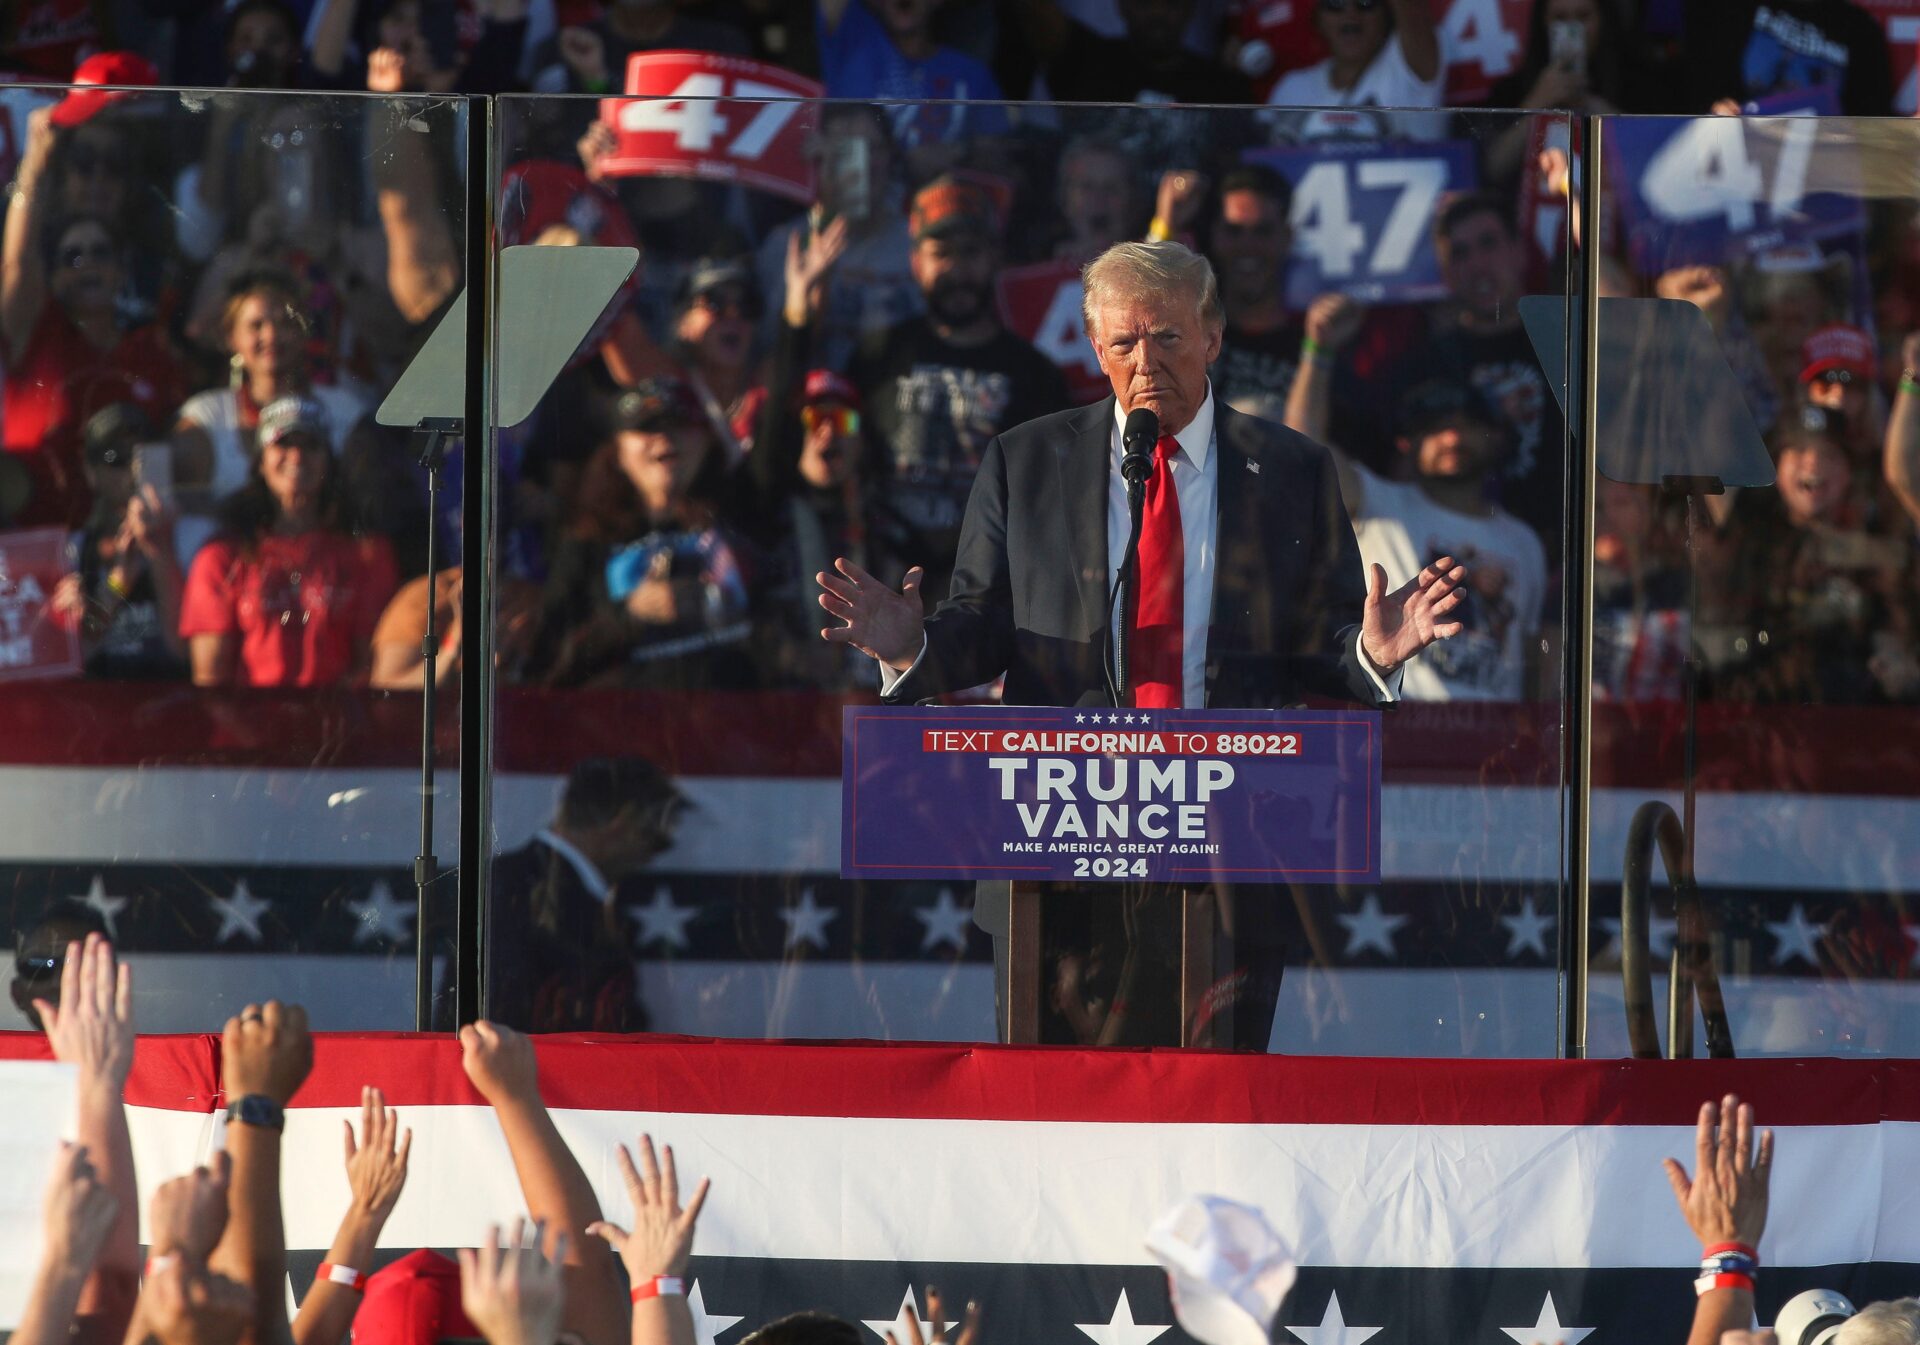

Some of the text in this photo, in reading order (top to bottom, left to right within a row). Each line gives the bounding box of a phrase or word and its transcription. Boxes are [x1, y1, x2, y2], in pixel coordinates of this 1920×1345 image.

[1437, 0, 1519, 76] 4
[618, 71, 803, 158] 47
[1286, 157, 1449, 277] 47
[1032, 280, 1100, 377] 4
[928, 731, 1297, 754] TEXT CALIFORNIA TO 88022
[988, 757, 1236, 802] TRUMP
[1016, 803, 1207, 839] VANCE
[1003, 842, 1220, 855] MAKE AMERICA GREAT AGAIN!
[1073, 857, 1149, 878] 2024
